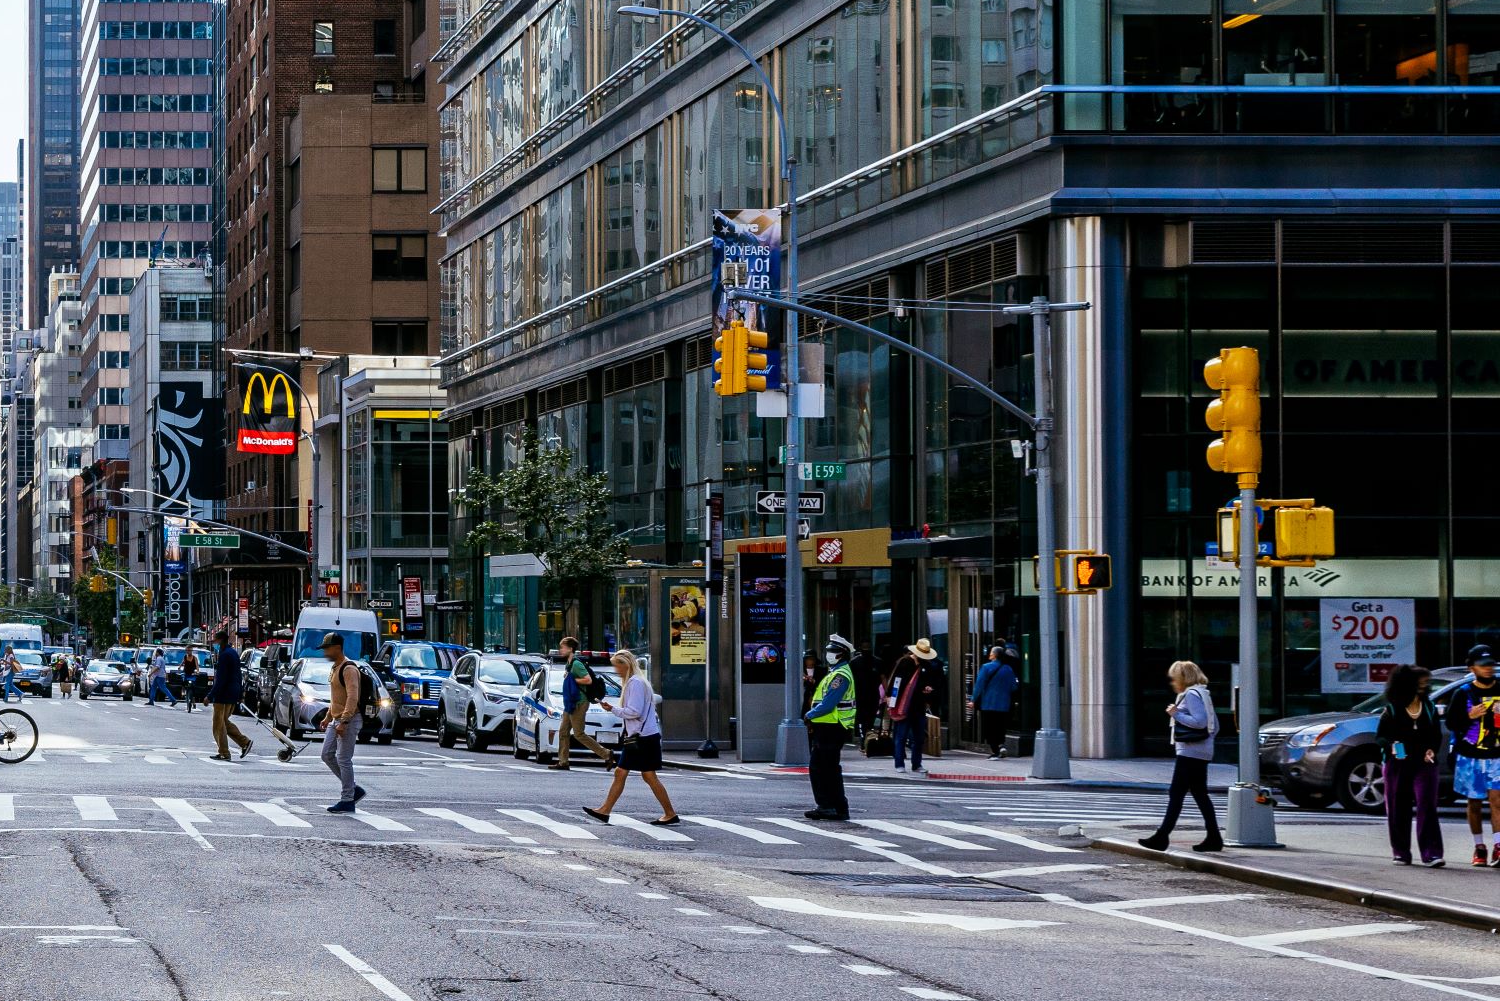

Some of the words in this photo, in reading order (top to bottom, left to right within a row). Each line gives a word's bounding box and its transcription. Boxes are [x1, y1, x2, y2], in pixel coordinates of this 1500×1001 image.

[725, 246, 736, 256] 20
[738, 246, 770, 256] YEARS
[243, 436, 294, 446] McDonald's
[815, 465, 821, 478] E
[823, 465, 835, 477] 59
[836, 465, 842, 473] St
[765, 498, 785, 507] ONE
[817, 538, 843, 563] HOME
[1141, 575, 1186, 587] BANK
[1192, 575, 1213, 587] OF
[721, 575, 729, 619] Newsstand
[1351, 601, 1373, 613] Get
[1375, 604, 1384, 613] a
[1331, 615, 1399, 641] $200
[1340, 642, 1360, 651] cash
[1361, 642, 1396, 651] rewards
[1344, 651, 1370, 660] bonus
[1370, 651, 1393, 660] offer
